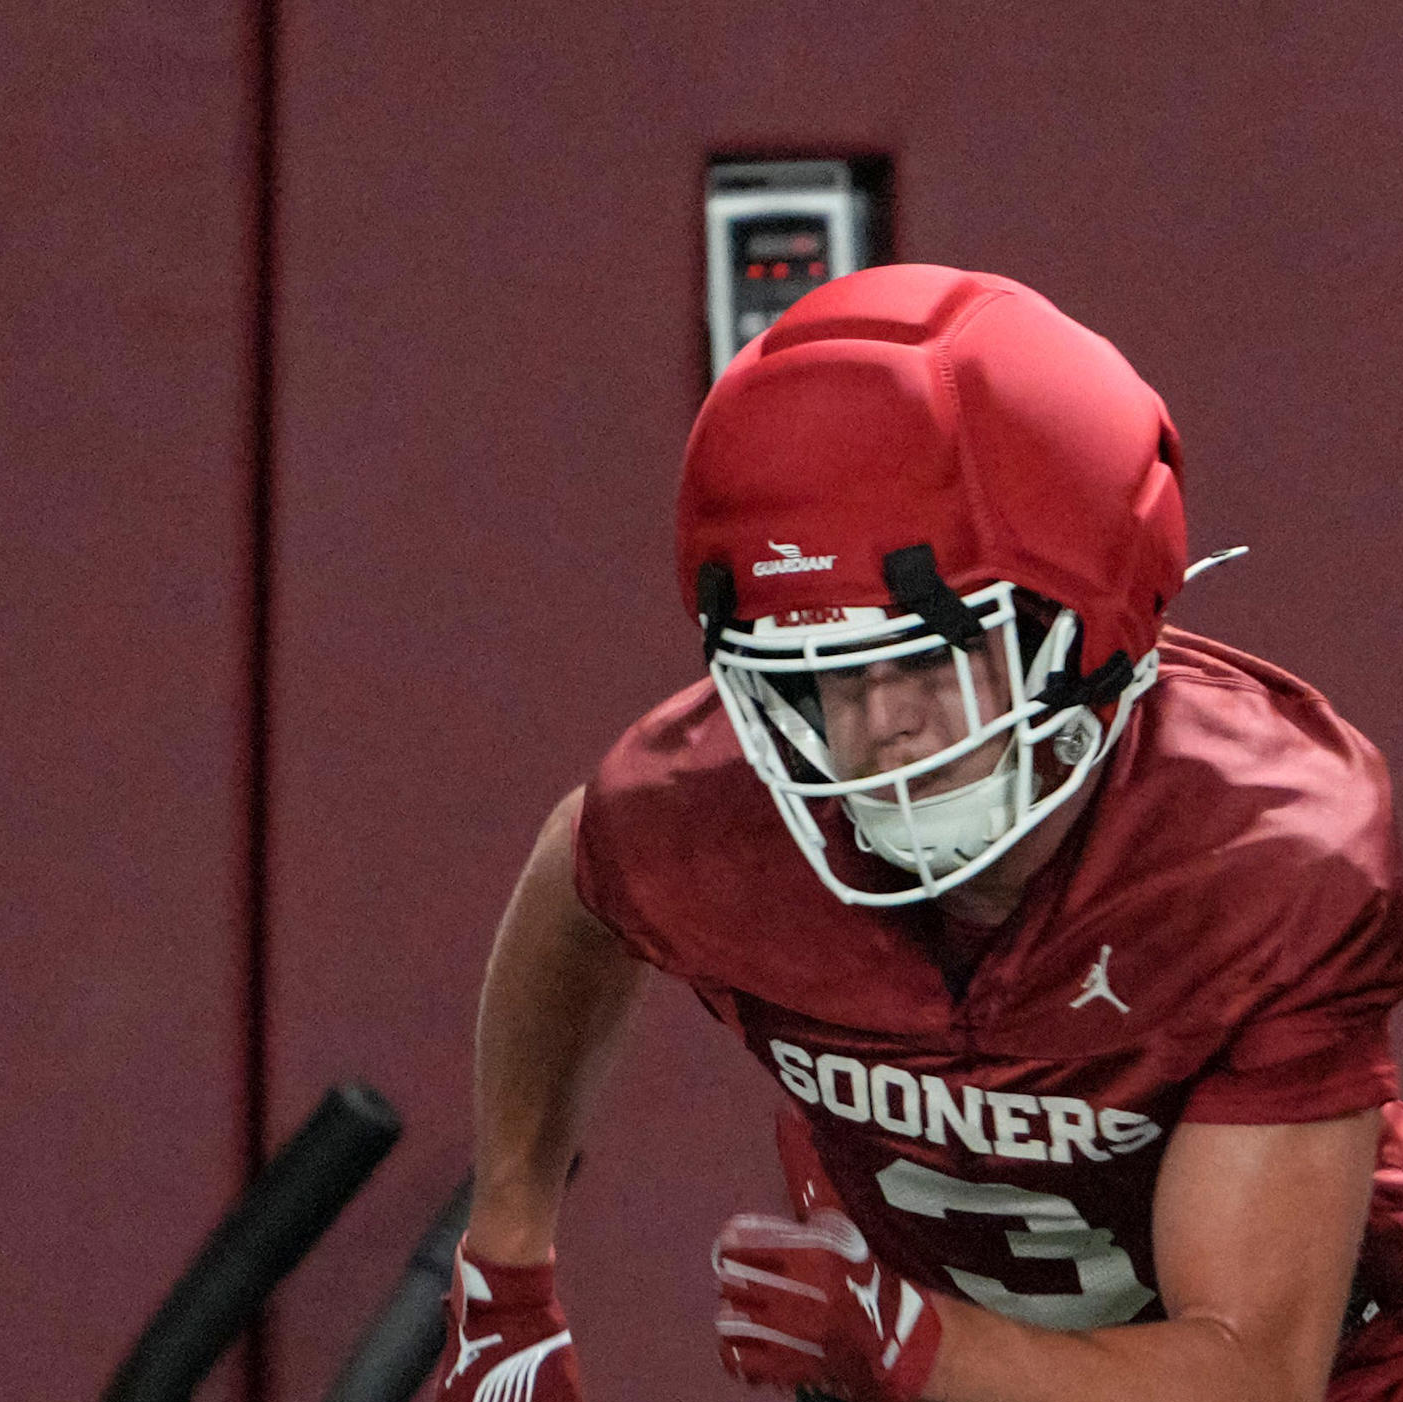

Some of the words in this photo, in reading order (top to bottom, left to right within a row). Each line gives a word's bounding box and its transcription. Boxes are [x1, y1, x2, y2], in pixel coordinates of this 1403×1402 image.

[752, 555, 837, 577] GUARDIAN
[769, 1038, 1162, 1164] SOONERS
[876, 1159, 1157, 1332] 3
